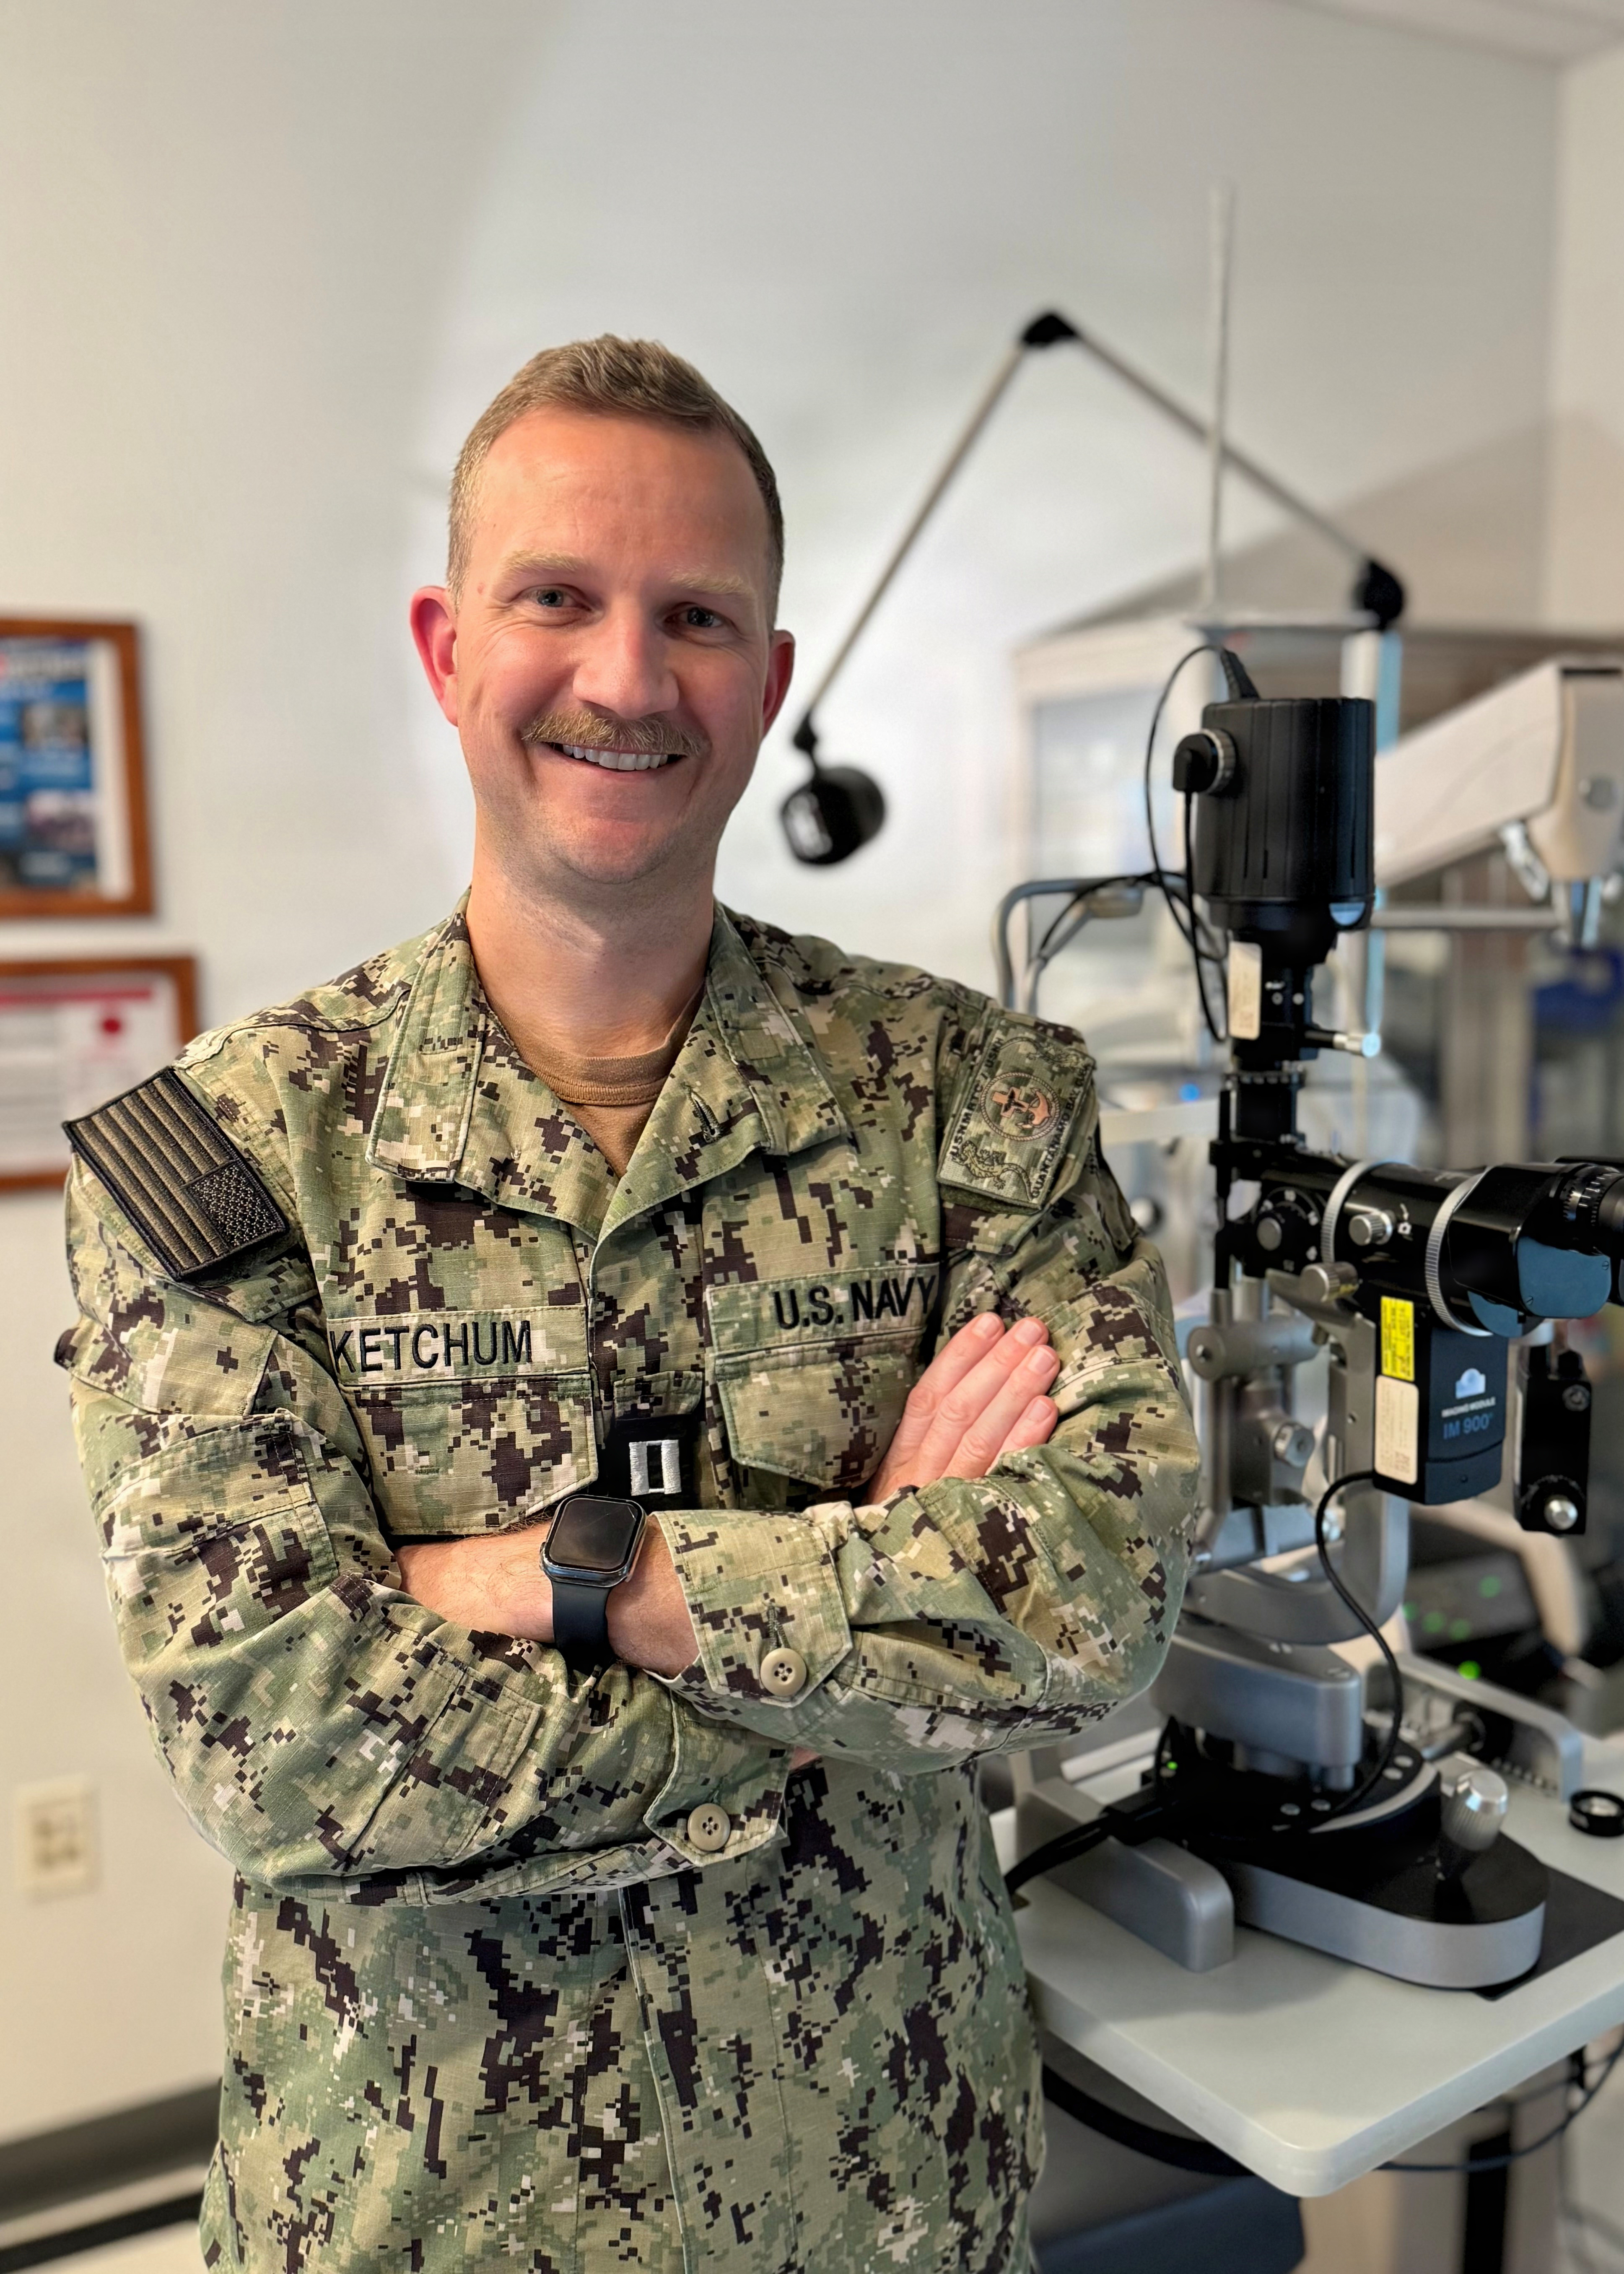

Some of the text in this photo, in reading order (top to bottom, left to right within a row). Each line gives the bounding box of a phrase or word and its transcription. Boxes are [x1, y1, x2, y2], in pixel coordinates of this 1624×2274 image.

[1032, 1112, 1070, 1199] GUANTANAMO
[773, 1275, 936, 1329] U.S. NAVY
[329, 1320, 532, 1373] KETCHUM
